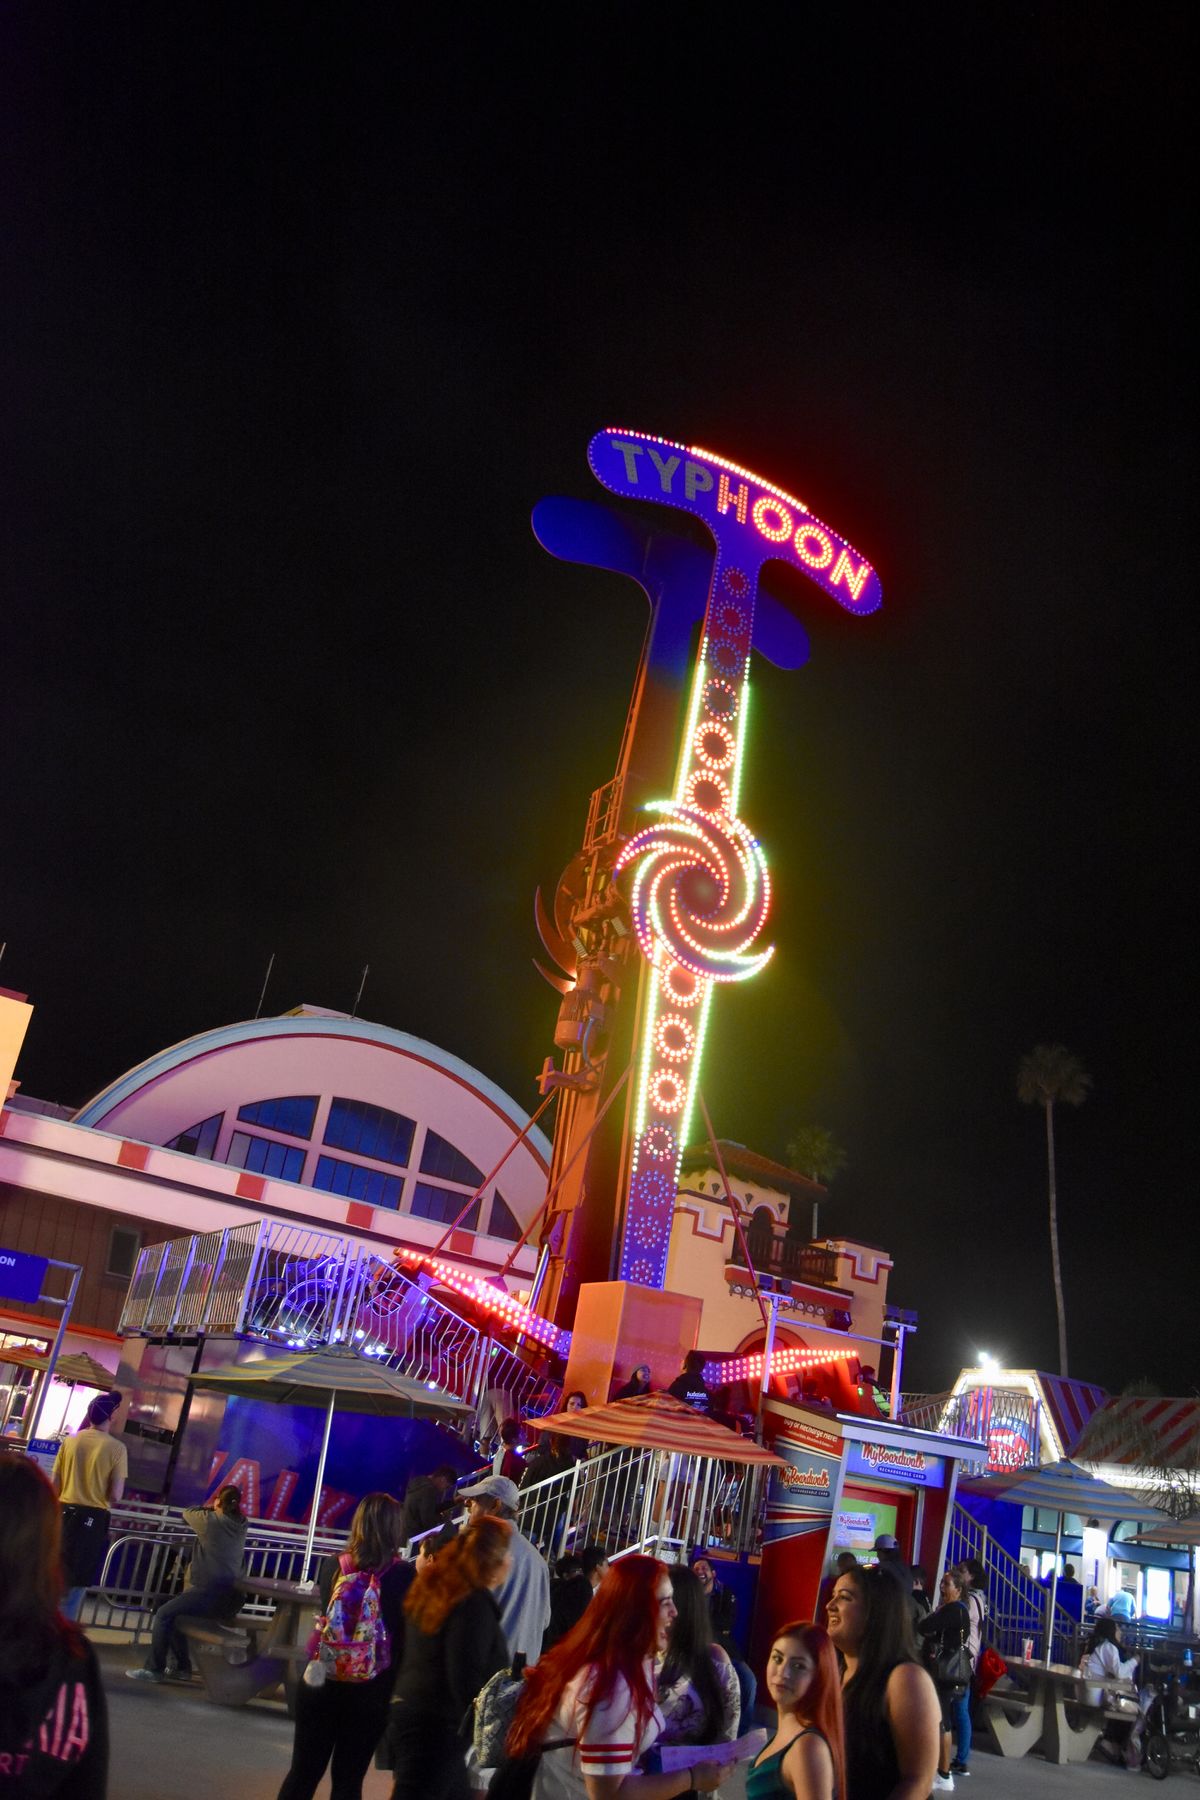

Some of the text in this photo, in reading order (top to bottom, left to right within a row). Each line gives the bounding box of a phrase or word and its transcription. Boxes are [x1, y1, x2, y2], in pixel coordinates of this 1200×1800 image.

[611, 439, 868, 600] TYPHOON
[32, 1440, 48, 1450] FUN
[861, 1440, 926, 1470] MyBoardwalk
